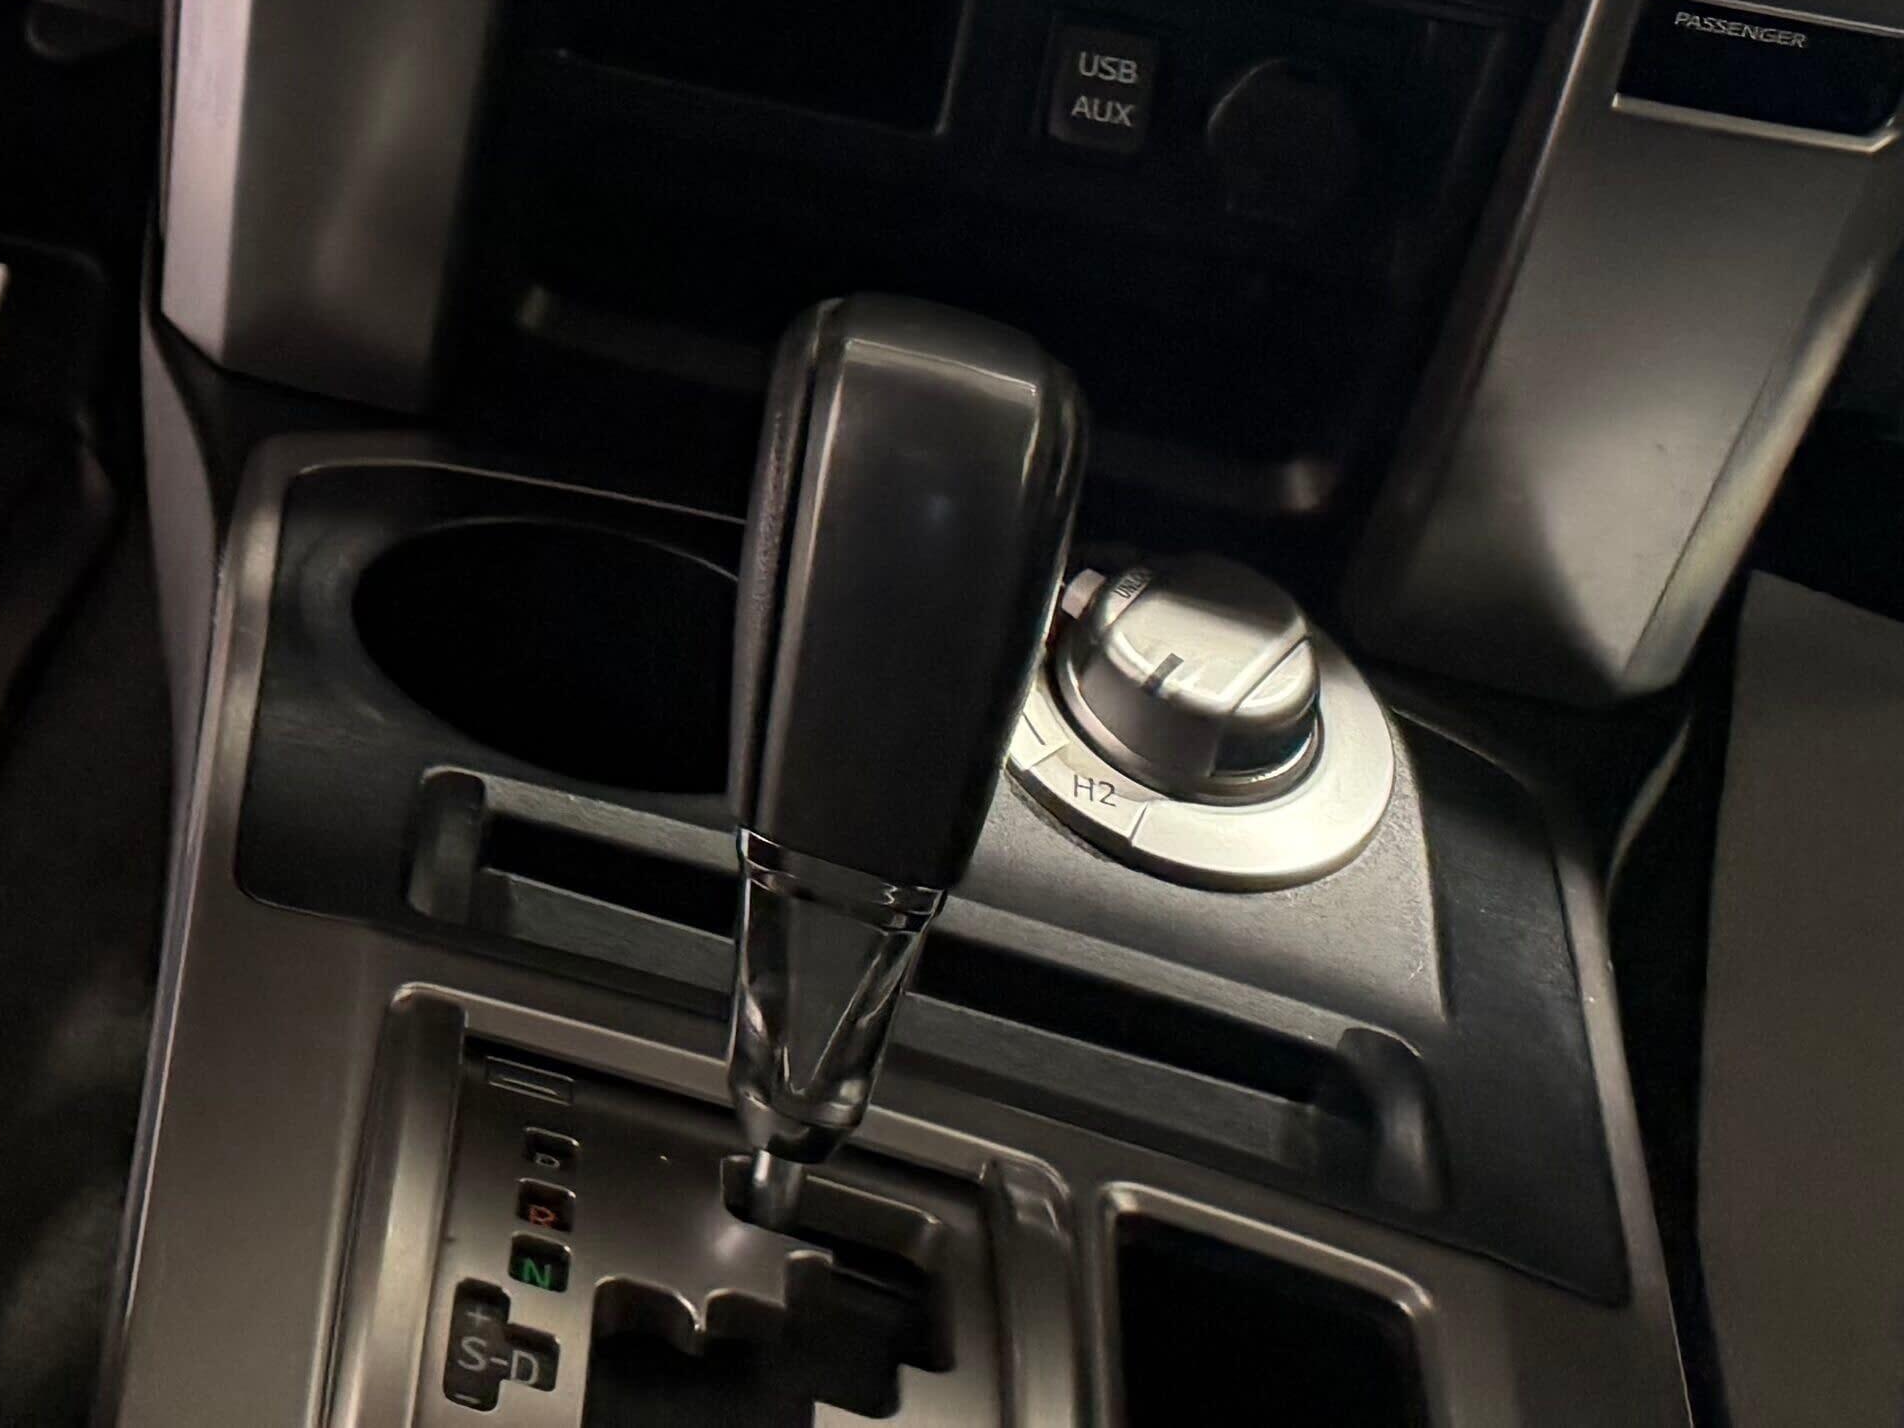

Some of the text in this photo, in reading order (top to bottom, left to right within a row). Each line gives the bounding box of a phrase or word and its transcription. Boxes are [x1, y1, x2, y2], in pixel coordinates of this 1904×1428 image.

[1673, 10, 1808, 49] PASSENGER
[1077, 50, 1139, 86] USB
[1070, 94, 1137, 128] AUX
[1072, 774, 1118, 808] H2
[520, 1256, 554, 1291] N
